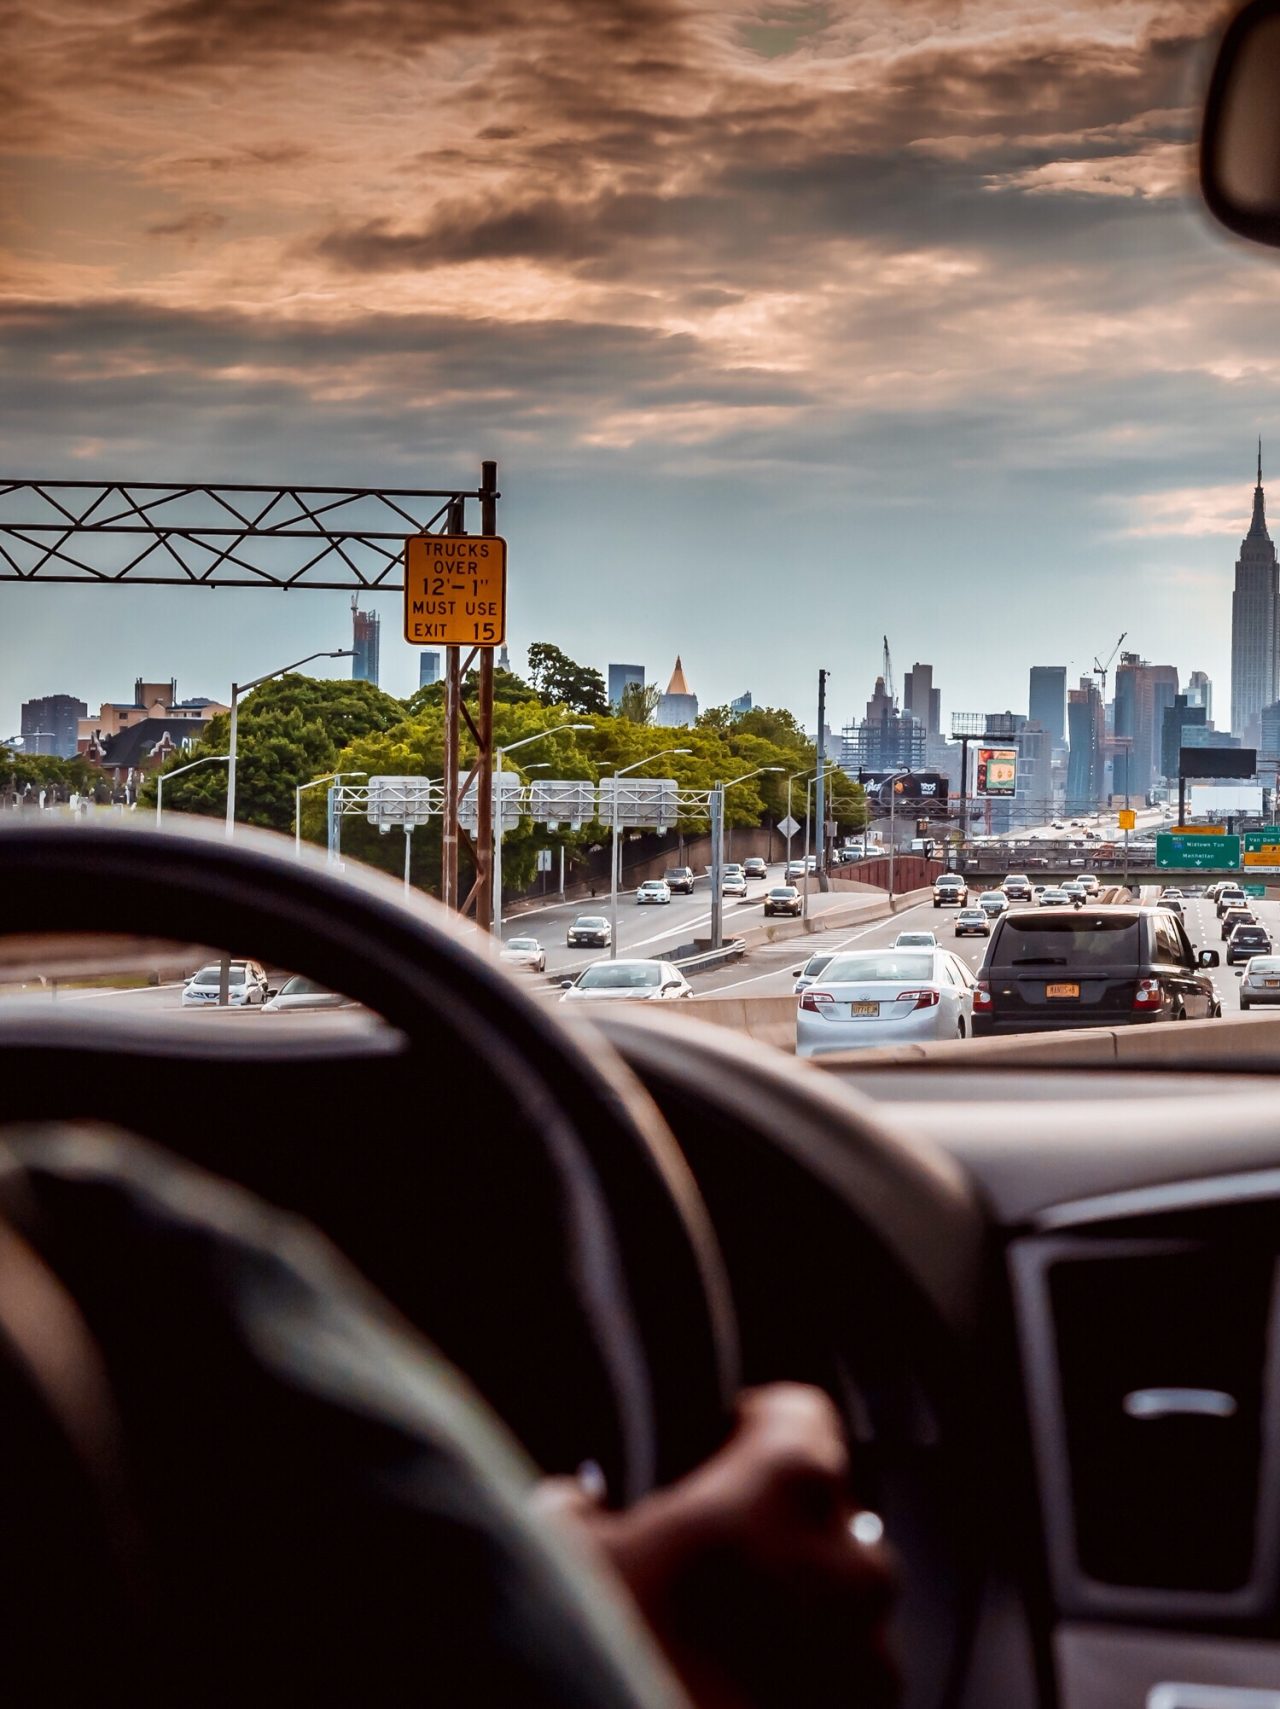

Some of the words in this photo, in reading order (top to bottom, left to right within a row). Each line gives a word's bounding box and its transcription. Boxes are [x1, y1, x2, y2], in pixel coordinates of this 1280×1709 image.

[424, 542, 489, 557] TRUCKS
[434, 560, 478, 575] OVER
[413, 601, 456, 615] MUST
[465, 602, 497, 616] USE
[414, 623, 447, 637] EXIT
[474, 622, 495, 640] 15
